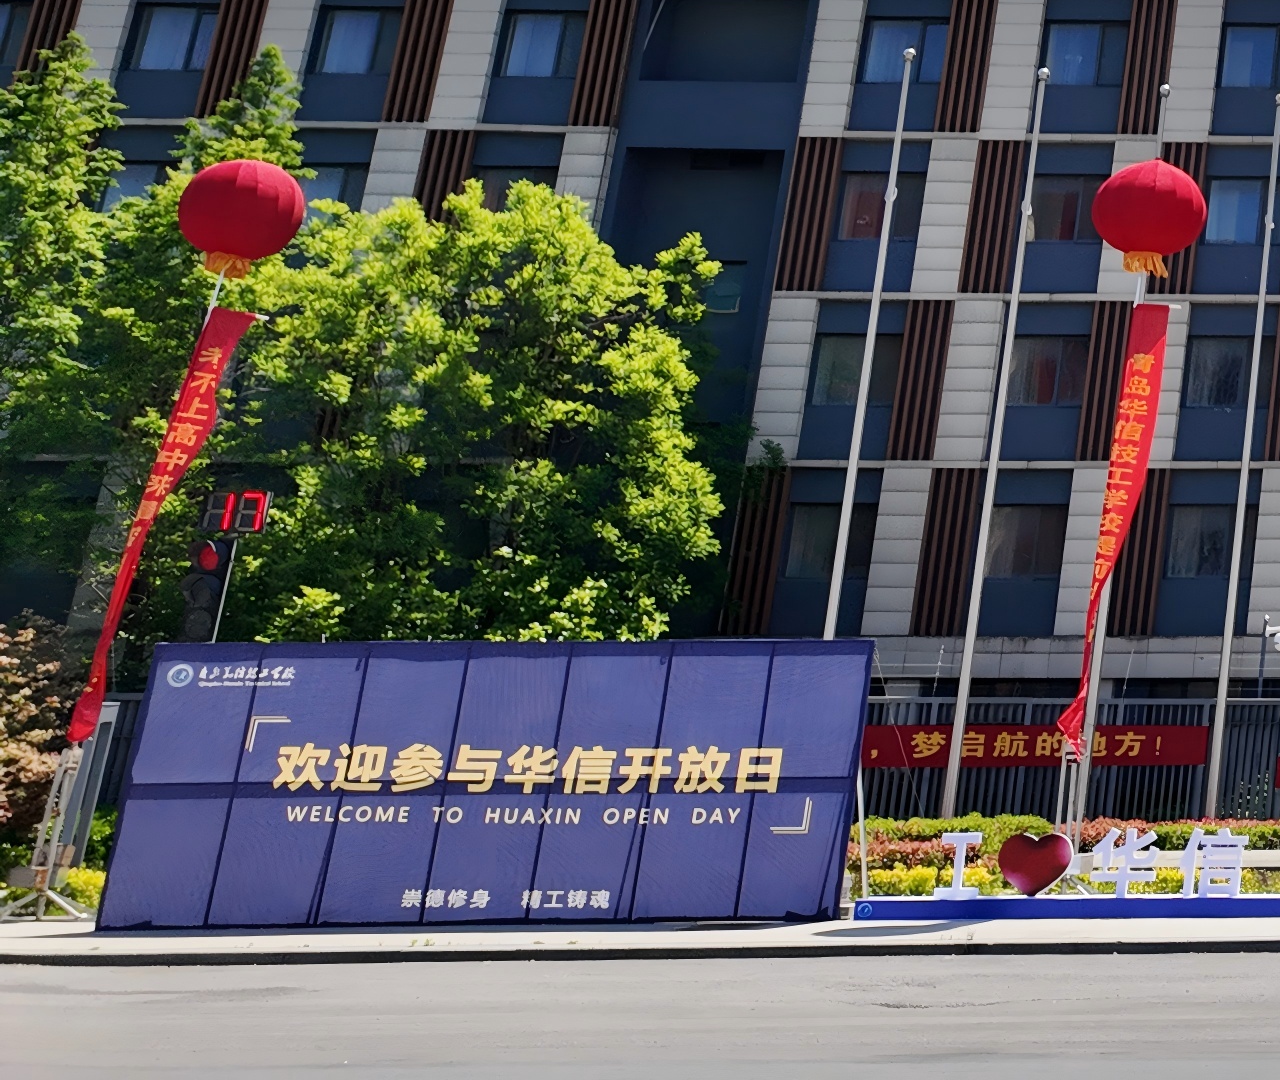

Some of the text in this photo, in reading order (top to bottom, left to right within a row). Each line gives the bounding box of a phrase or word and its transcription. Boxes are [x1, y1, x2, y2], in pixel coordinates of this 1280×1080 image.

[219, 490, 268, 532] 17
[272, 743, 784, 795] 欢迎参与华信开放日
[286, 805, 742, 827] WELCOME TO HUAXIN OPEN DAY
[1090, 826, 1250, 898] 华信
[401, 889, 611, 911] 崇德修身 精工铸魂
